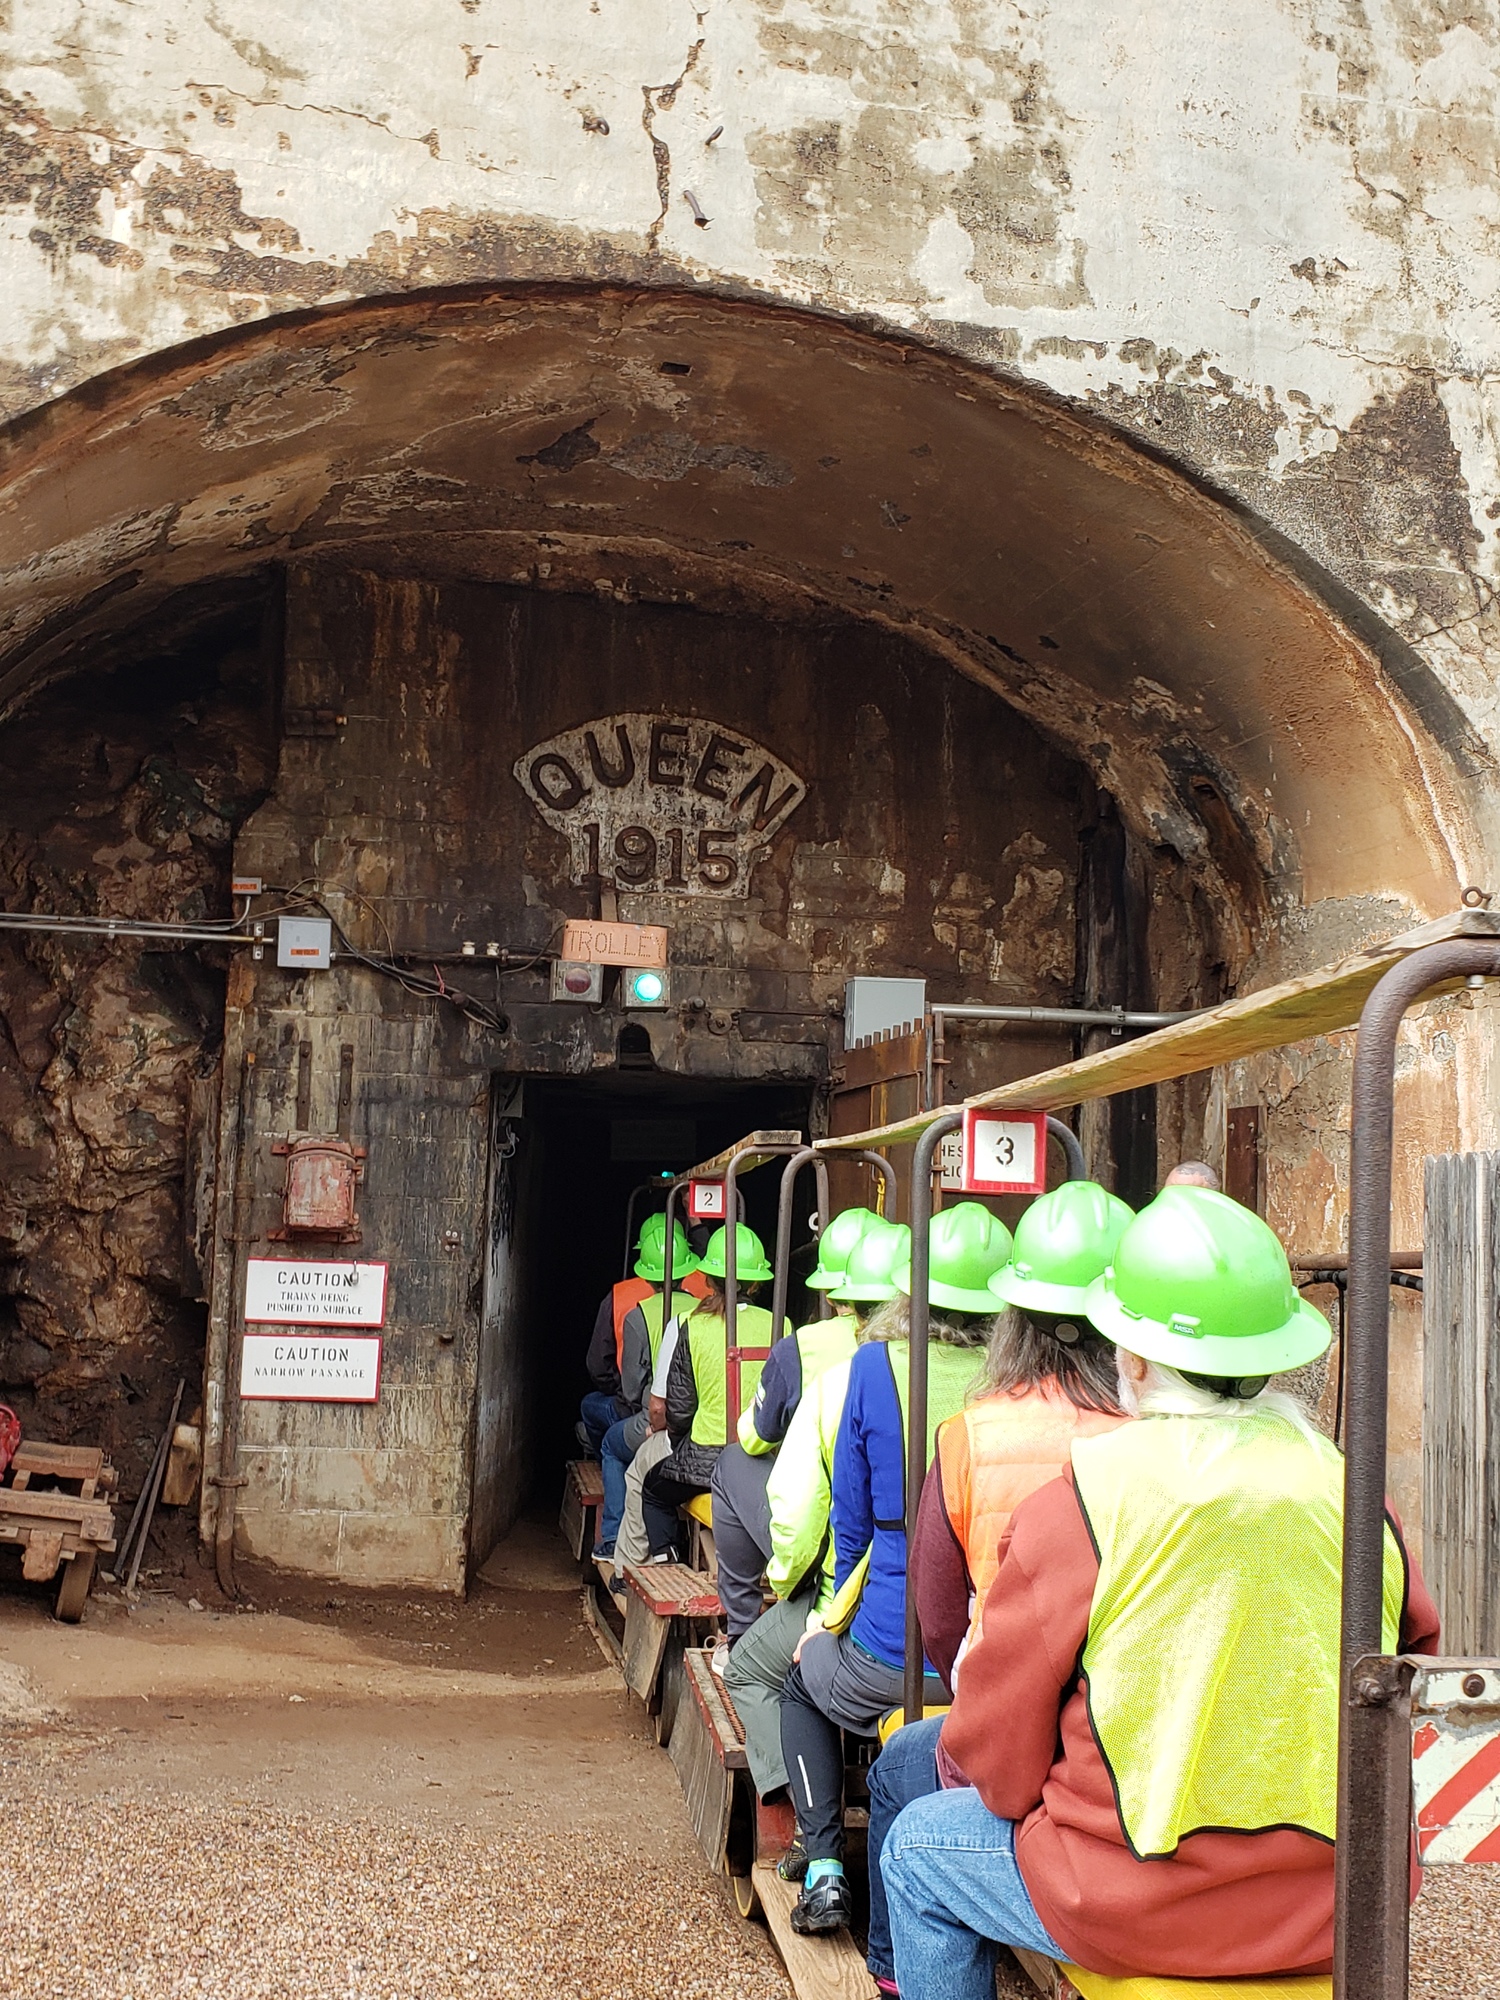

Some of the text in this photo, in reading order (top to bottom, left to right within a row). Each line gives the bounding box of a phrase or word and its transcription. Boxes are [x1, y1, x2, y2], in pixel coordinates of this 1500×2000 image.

[529, 721, 800, 832] QUEEN
[582, 823, 738, 891] 1915
[567, 930, 666, 960] TROLLEY
[996, 1136, 1015, 1165] 3
[703, 1191, 713, 1206] 2
[277, 1271, 353, 1287] CAUTION
[280, 1291, 349, 1303] TRAINS BEING
[266, 1303, 364, 1316] PUSHED TO SURFACE
[274, 1346, 349, 1362] CAUTION
[254, 1367, 366, 1379] NARROW PASSAGE
